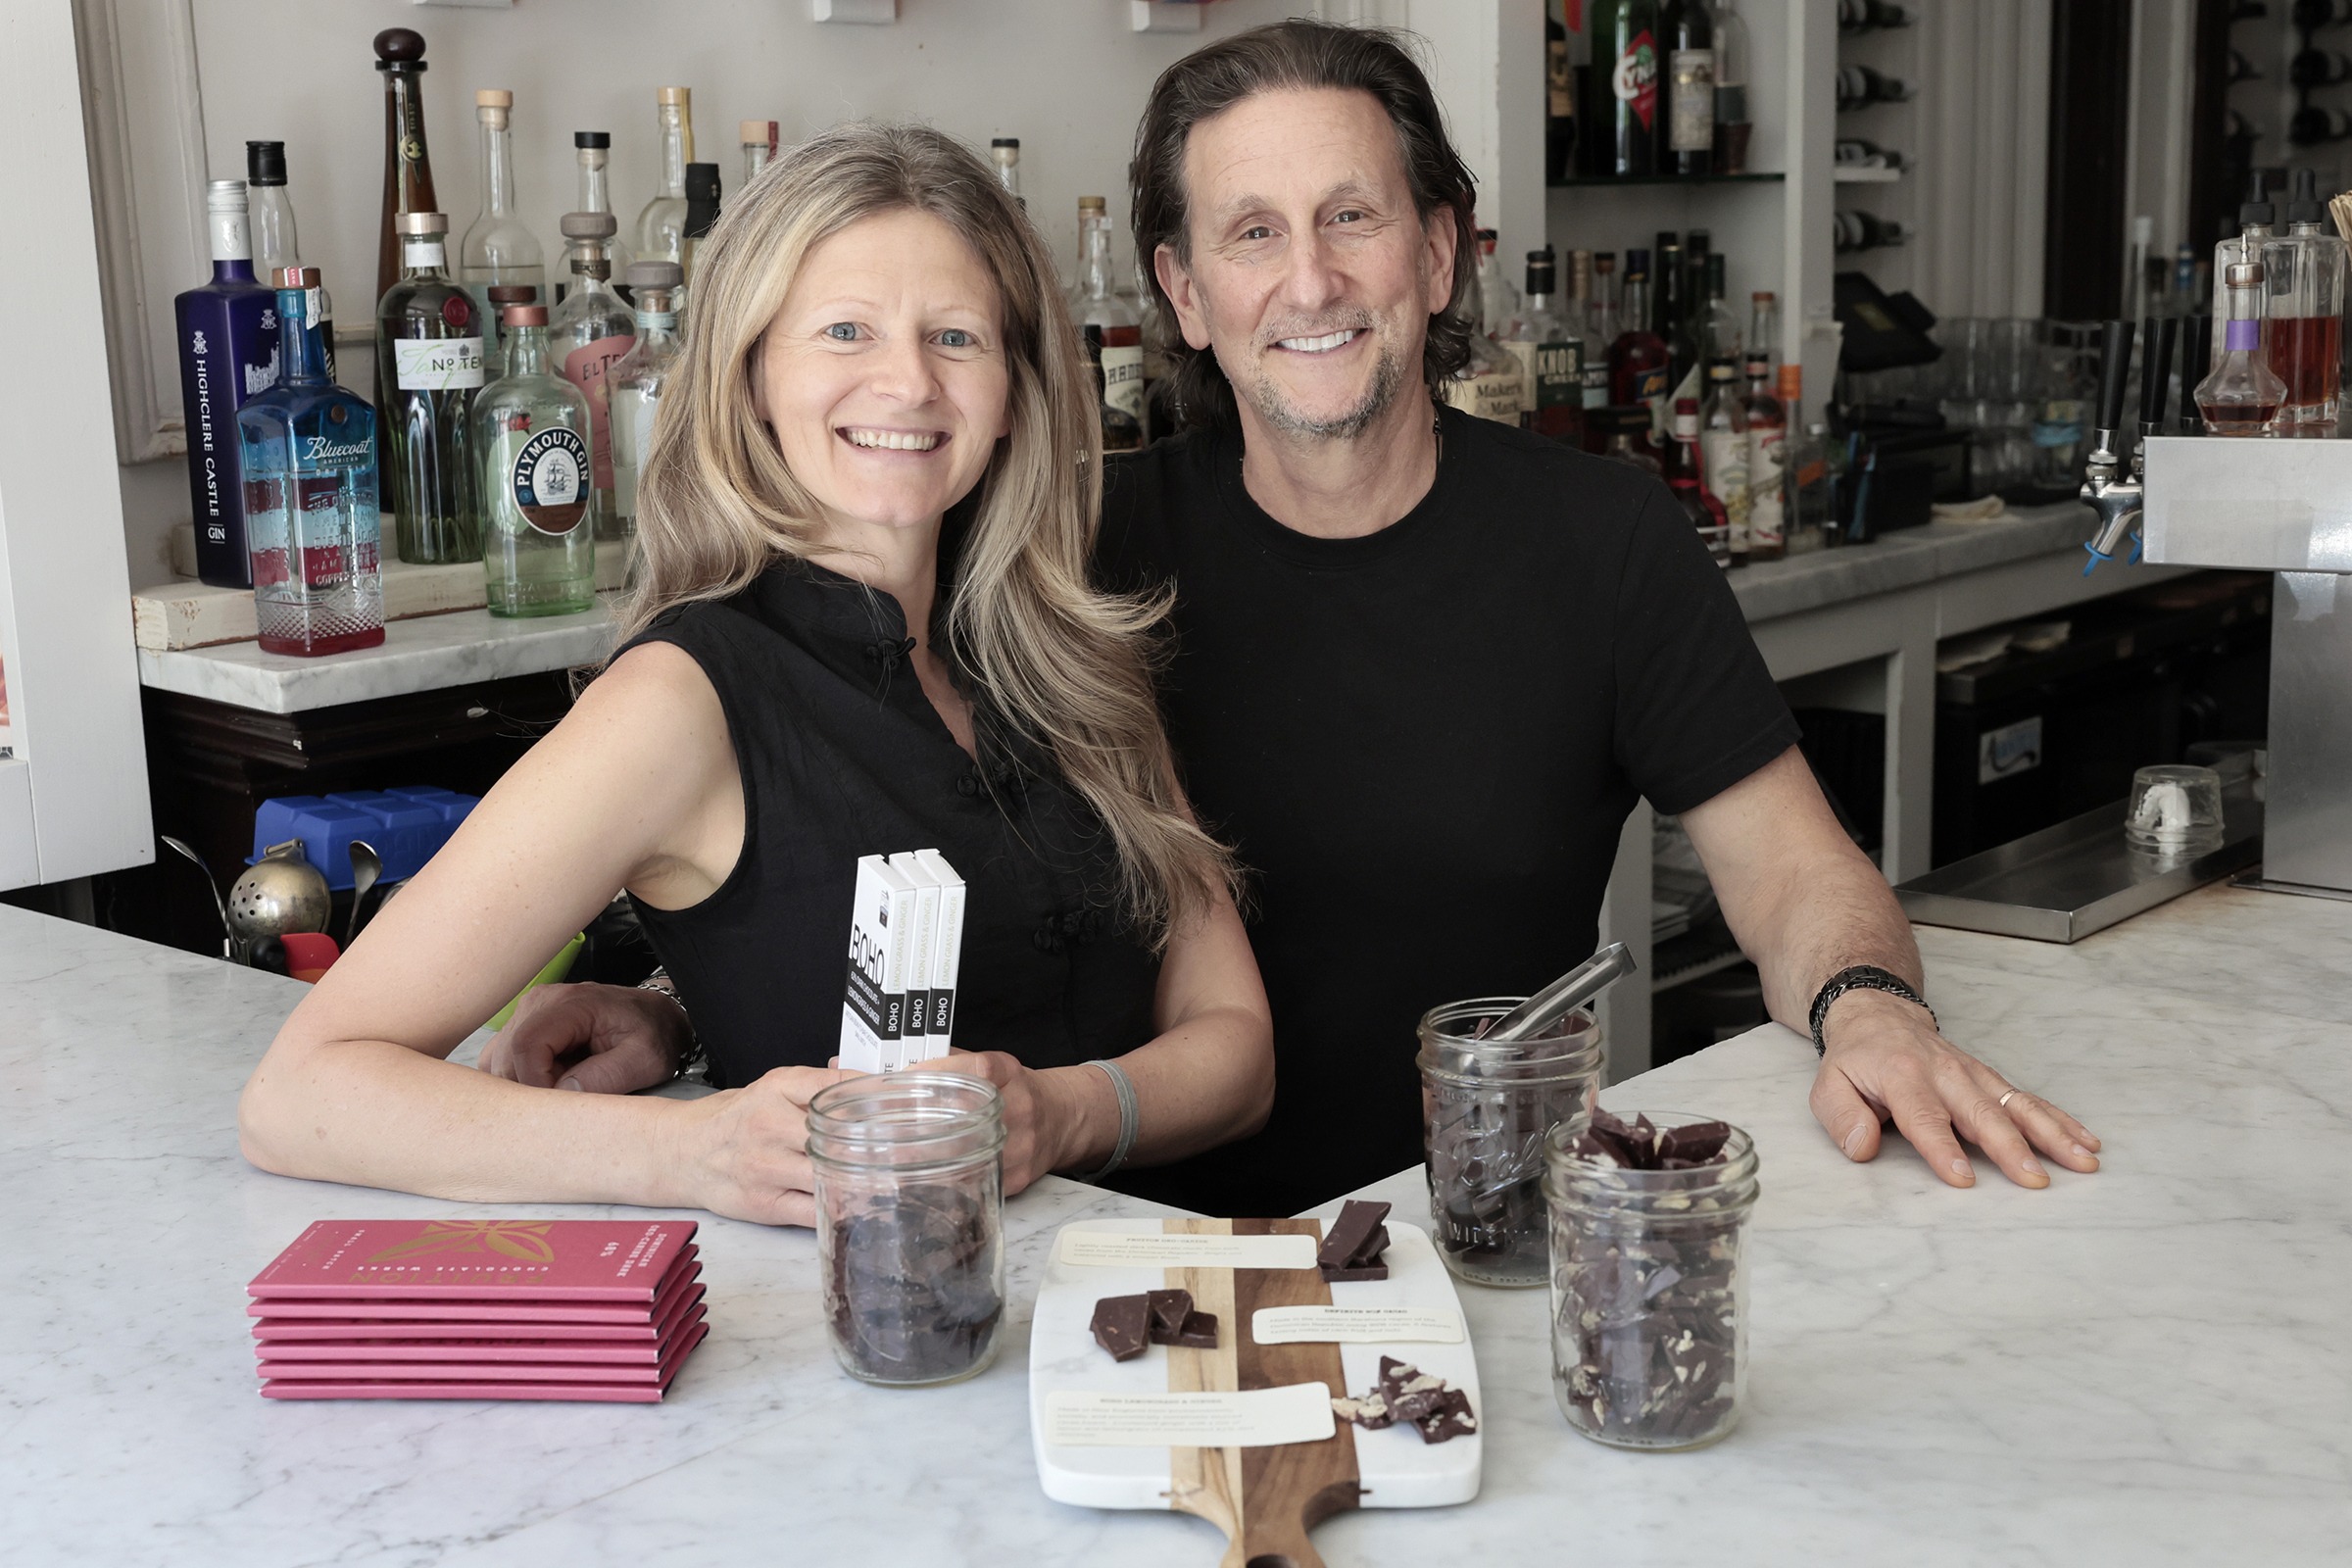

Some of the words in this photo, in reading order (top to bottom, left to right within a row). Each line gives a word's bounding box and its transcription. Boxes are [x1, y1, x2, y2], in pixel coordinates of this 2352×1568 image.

[1538, 348, 1577, 375] KNOB
[196, 359, 214, 452] HIGHCLERE
[205, 457, 220, 517] CASTLE
[303, 436, 374, 460] Bluecoat
[316, 467, 338, 476] DRY
[322, 456, 359, 466] AMERICAN
[516, 432, 580, 487] PLYMOUTH
[576, 451, 588, 481] GIN
[208, 526, 225, 540] GIN
[900, 899, 908, 930] GINGER
[923, 896, 932, 926] GINGER
[949, 895, 957, 925] GINGER
[850, 923, 885, 986] BOHO
[896, 937, 906, 963] GRASS
[920, 933, 929, 959] GRASS
[945, 931, 955, 958] GRASS
[894, 963, 903, 992] LEMON
[917, 959, 926, 988] LEMON
[942, 958, 951, 987] LEMON
[888, 1002, 900, 1032] BOHO
[911, 999, 924, 1028] BOHO
[936, 997, 949, 1027] BOHO
[349, 1273, 544, 1284] FRUITION
